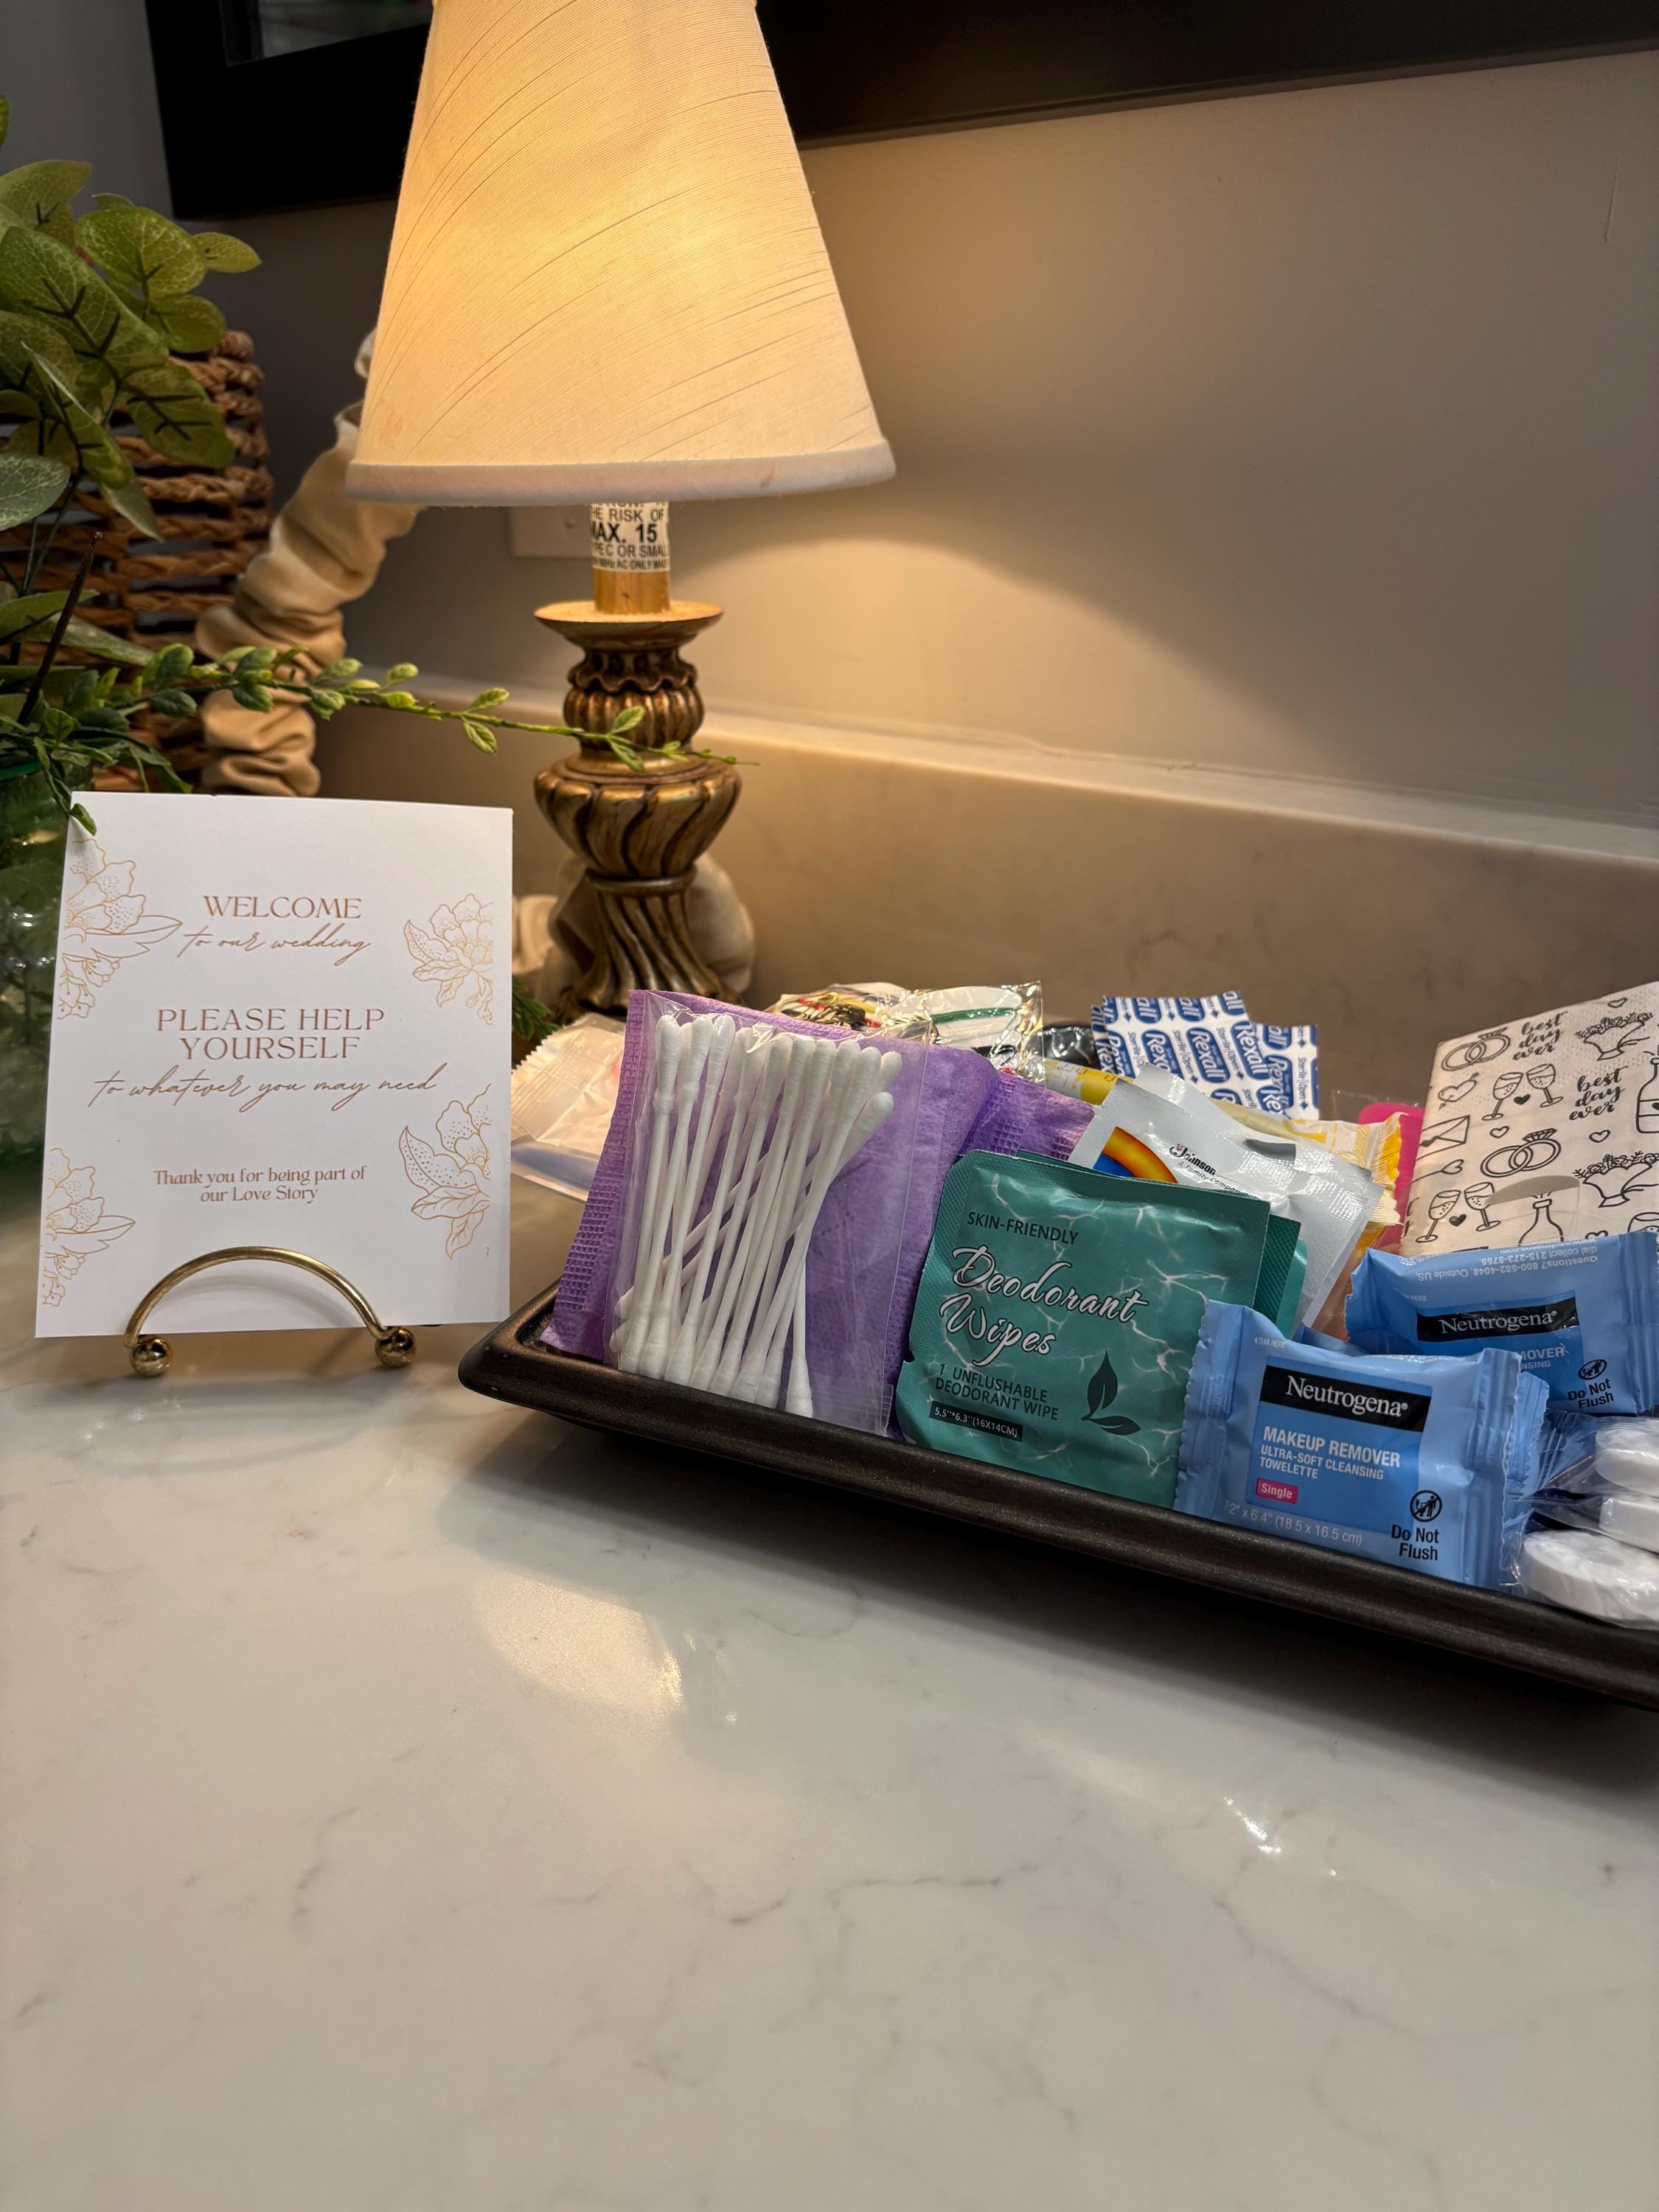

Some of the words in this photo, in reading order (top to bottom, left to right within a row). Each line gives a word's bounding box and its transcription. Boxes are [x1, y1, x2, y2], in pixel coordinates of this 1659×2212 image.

[591, 507, 602, 521] HE
[609, 509, 643, 522] RISK
[650, 509, 664, 522] OF
[636, 524, 657, 543] 15
[617, 545, 636, 557] OR
[639, 545, 667, 557] SMAL
[203, 895, 362, 919] WELCOME
[178, 925, 212, 958] to
[218, 931, 265, 951] our
[271, 923, 371, 966] wedding
[156, 1008, 286, 1031] PLEASE
[299, 1008, 385, 1030] HELP
[1522, 1011, 1568, 1035] best
[179, 1036, 361, 1060] YOURSELF
[1234, 1020, 1269, 1074] Rexall
[1519, 1029, 1565, 1048] day
[1145, 1032, 1171, 1071] Rexa
[1190, 1029, 1227, 1081] Rexall
[1512, 1043, 1555, 1060] ever
[88, 1070, 126, 1107] to
[130, 1065, 251, 1106] whatever
[239, 1080, 306, 1113] you
[313, 1079, 370, 1111] may
[378, 1062, 448, 1090] need
[1577, 1065, 1629, 1092] best
[1260, 1088, 1283, 1116] Rex
[1575, 1086, 1626, 1107] day
[1569, 1102, 1615, 1120] ever
[153, 1169, 202, 1185] Thank
[206, 1172, 235, 1188] you
[240, 1169, 264, 1183] for
[268, 1167, 310, 1186] being
[314, 1168, 346, 1185] part
[351, 1166, 367, 1180] of
[1210, 1178, 1240, 1192] Compa
[201, 1190, 229, 1202] our
[233, 1187, 271, 1201] Love
[276, 1185, 319, 1203] Story
[967, 1211, 1079, 1245] SKIN-FRIENDLY
[1549, 1247, 1579, 1258] collect
[1581, 1245, 1598, 1256] dial
[1541, 1255, 1598, 1270] Questions?
[951, 1245, 1150, 1324] Deodorant
[1415, 1271, 1433, 1281] US,
[1433, 1268, 1469, 1280] Outside
[939, 1294, 1056, 1367] Wipes
[1521, 1346, 1565, 1360] MOVER
[1521, 1360, 1551, 1369] NSING
[940, 1363, 946, 1376] 1
[953, 1367, 1048, 1402] UNFLUSHABLE
[1568, 1390, 1586, 1402] Do
[1589, 1378, 1611, 1395] Not
[935, 1377, 1020, 1411] DEODORANT
[1023, 1401, 1059, 1421] WIPE
[1578, 1392, 1614, 1409] Flush
[1263, 1426, 1326, 1452] MAKEUP
[1329, 1439, 1400, 1468] REMOVER
[1259, 1456, 1318, 1479] TOWELETTE
[1261, 1444, 1324, 1467] ULTRA-SOFT
[1325, 1459, 1384, 1480] CLEANSING
[1261, 1483, 1293, 1499] Single
[1242, 1509, 1248, 1518] x
[1275, 1515, 1303, 1533] (18.5
[1305, 1524, 1311, 1534] x
[1315, 1525, 1339, 1541] 16.5
[1342, 1531, 1363, 1546] cm)
[1391, 1524, 1411, 1541] Do
[1416, 1528, 1439, 1544] Not
[1399, 1542, 1438, 1561] Flush
